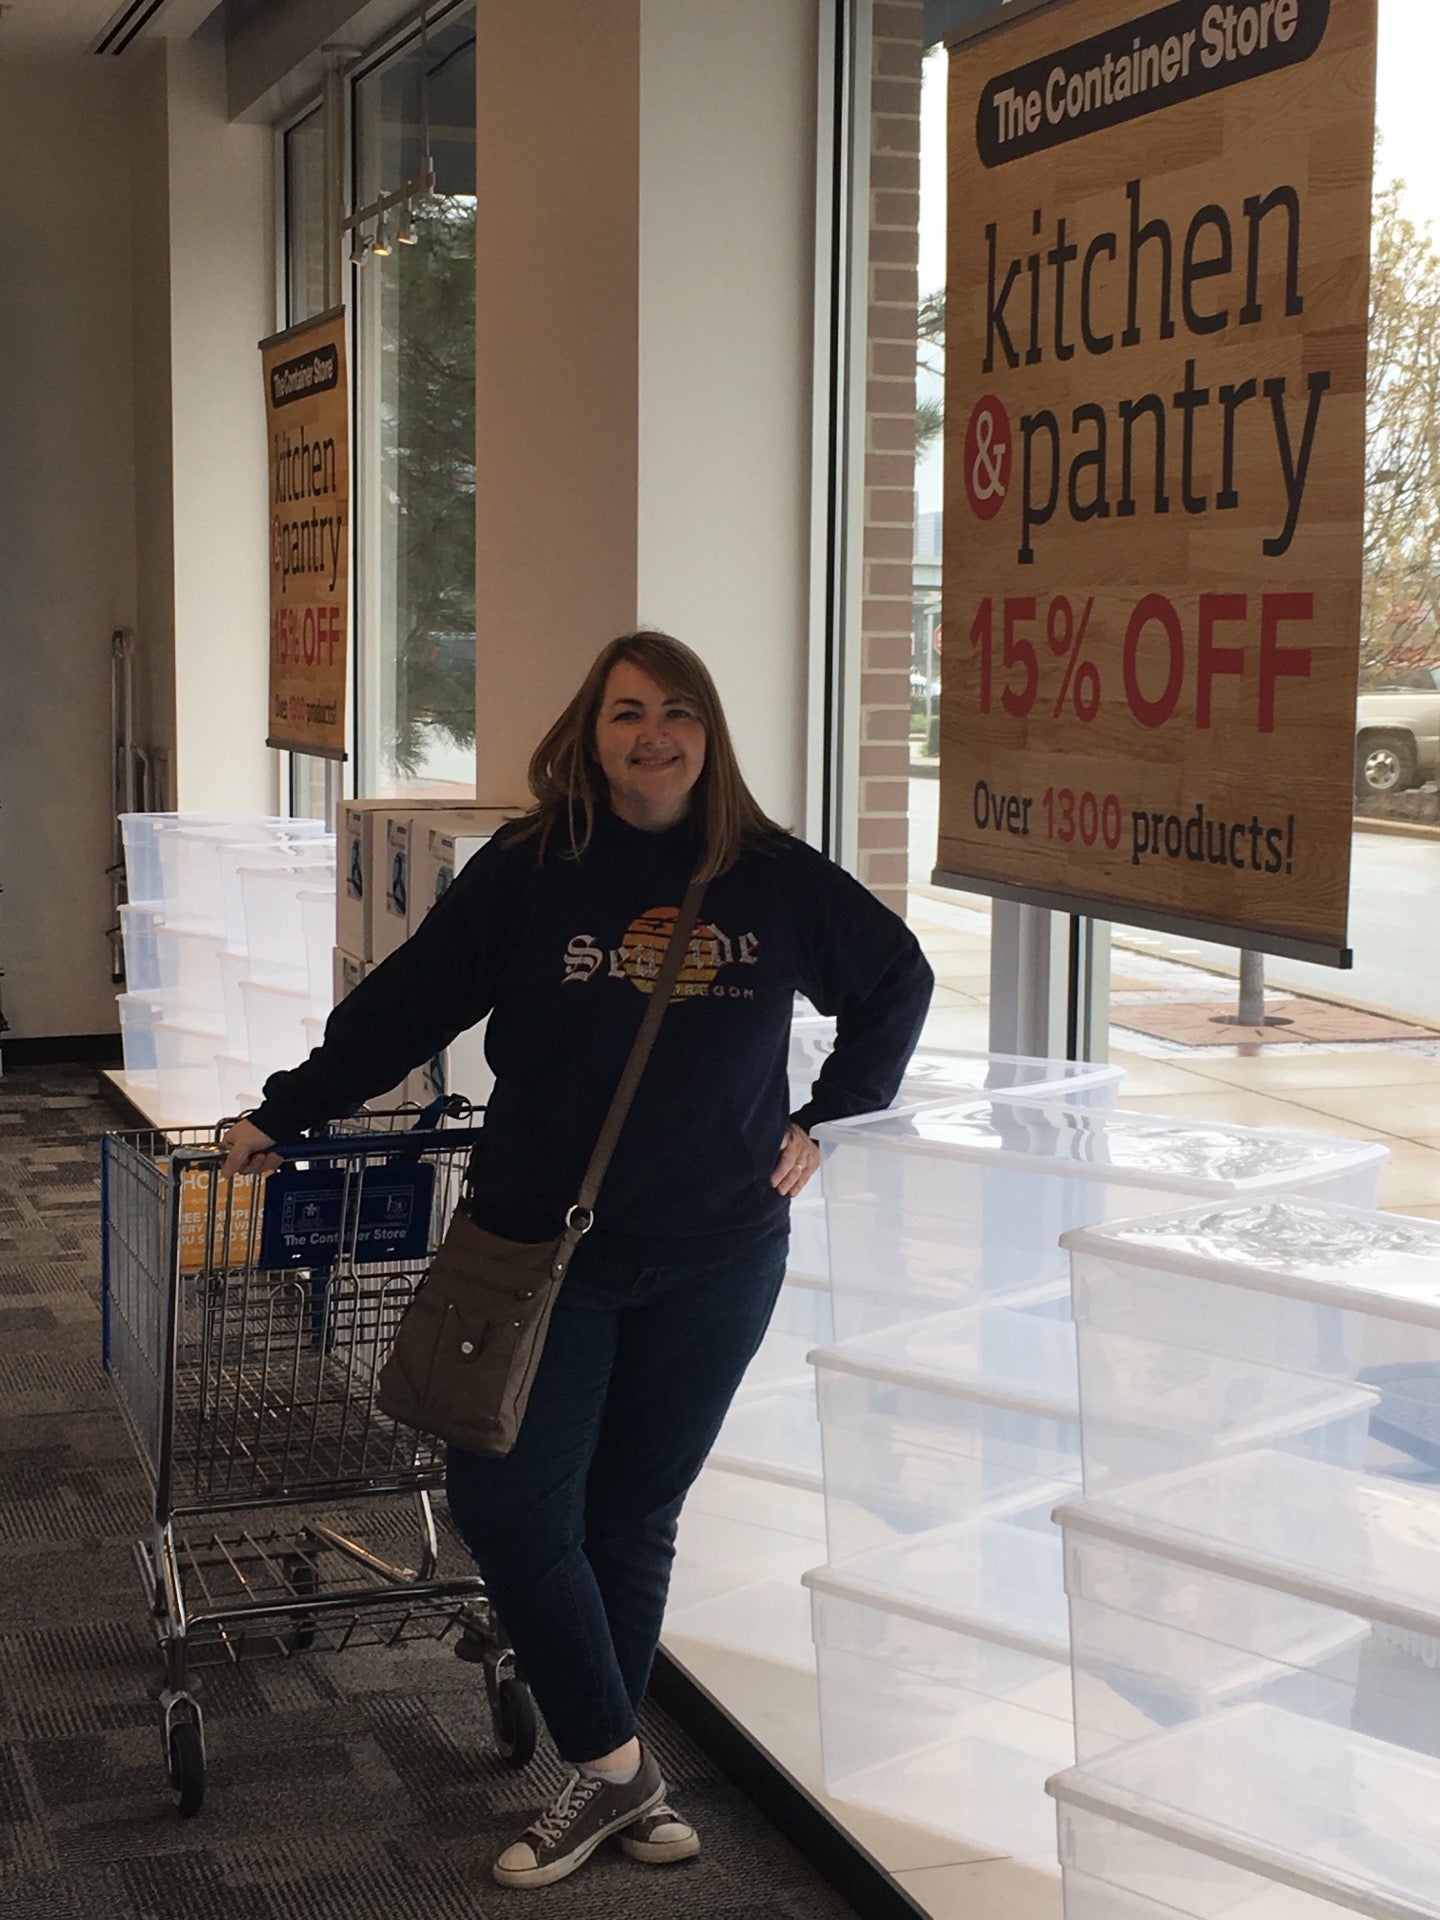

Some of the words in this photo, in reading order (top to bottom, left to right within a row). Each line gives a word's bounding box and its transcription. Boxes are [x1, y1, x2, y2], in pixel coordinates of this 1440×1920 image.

[994, 86, 1042, 144] The
[1045, 26, 1196, 125] Container
[1201, 0, 1299, 69] Store
[982, 178, 1304, 374] kitchen
[275, 425, 337, 504] kitchen
[1018, 358, 1331, 565] pantry
[283, 506, 342, 593] pantry
[303, 606, 341, 668] OFF
[969, 594, 1101, 724] 15%
[1122, 592, 1315, 734] OFF
[973, 780, 1033, 836] Over
[1042, 786, 1122, 850] 1300
[1131, 803, 1295, 875] products!
[561, 923, 760, 985] Seaide
[283, 1234, 307, 1246] The
[310, 1231, 370, 1245] Contier
[373, 1228, 407, 1240] Store
